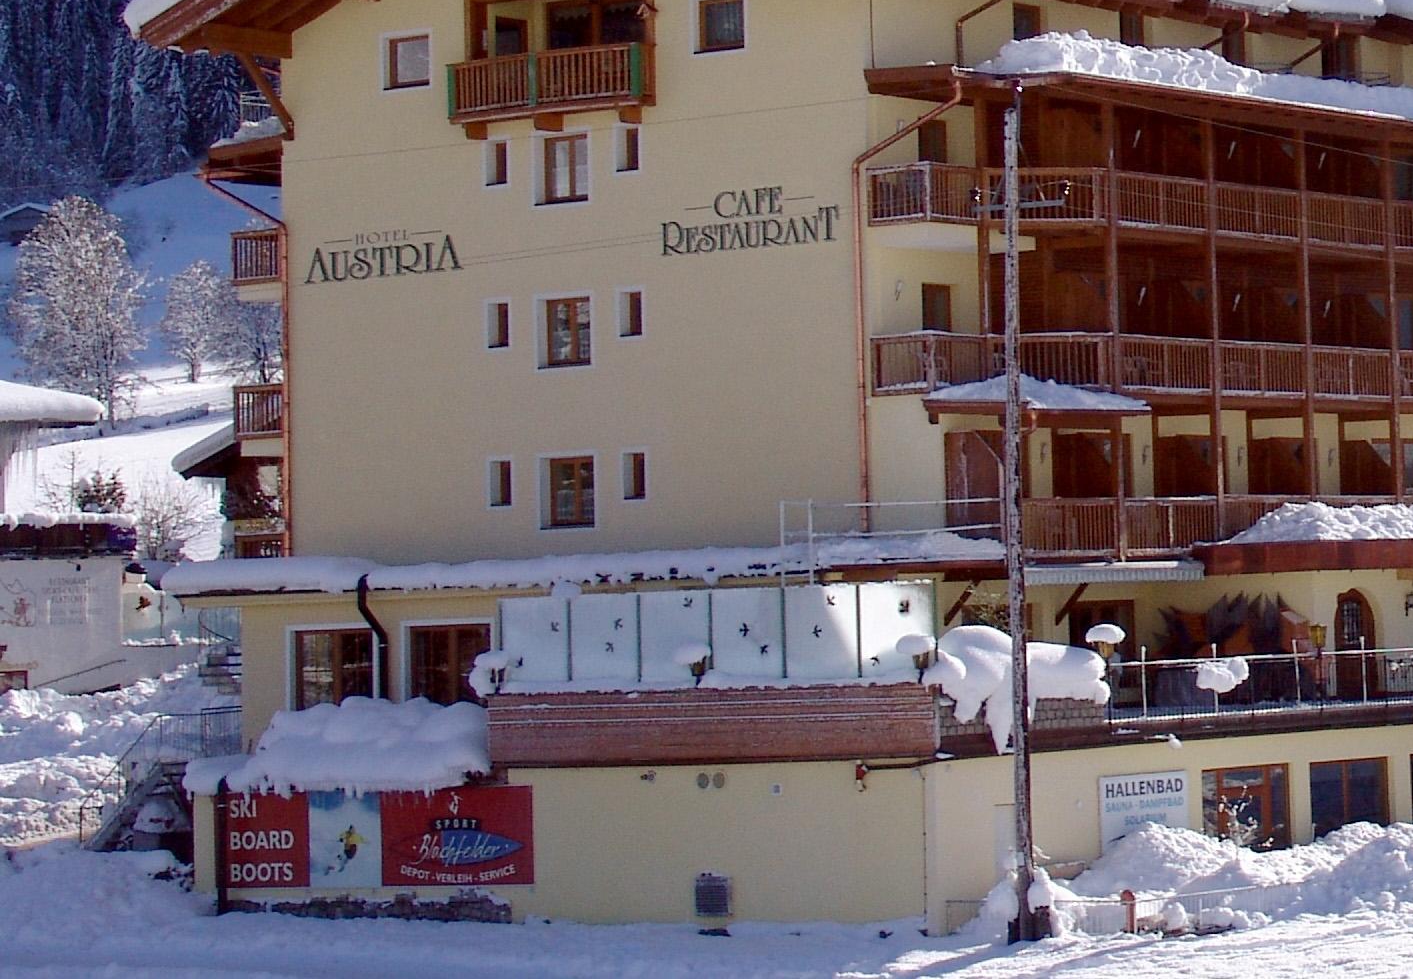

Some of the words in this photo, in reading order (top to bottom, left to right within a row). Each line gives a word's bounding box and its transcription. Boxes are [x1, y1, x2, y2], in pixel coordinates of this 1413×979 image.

[713, 186, 783, 219] CAFE
[355, 229, 409, 245] HOTEL
[661, 204, 839, 257] RESTAURANT
[304, 234, 464, 284] AUSTRIA
[1105, 778, 1183, 799] HALLENBAD
[230, 799, 257, 818] SKI
[435, 819, 478, 830] SPORT
[230, 830, 295, 851] BOARD
[231, 862, 294, 883] BOOTS
[400, 864, 431, 880] DEPOT
[435, 872, 473, 884] VERLEIH
[479, 863, 517, 882] SERVICE
